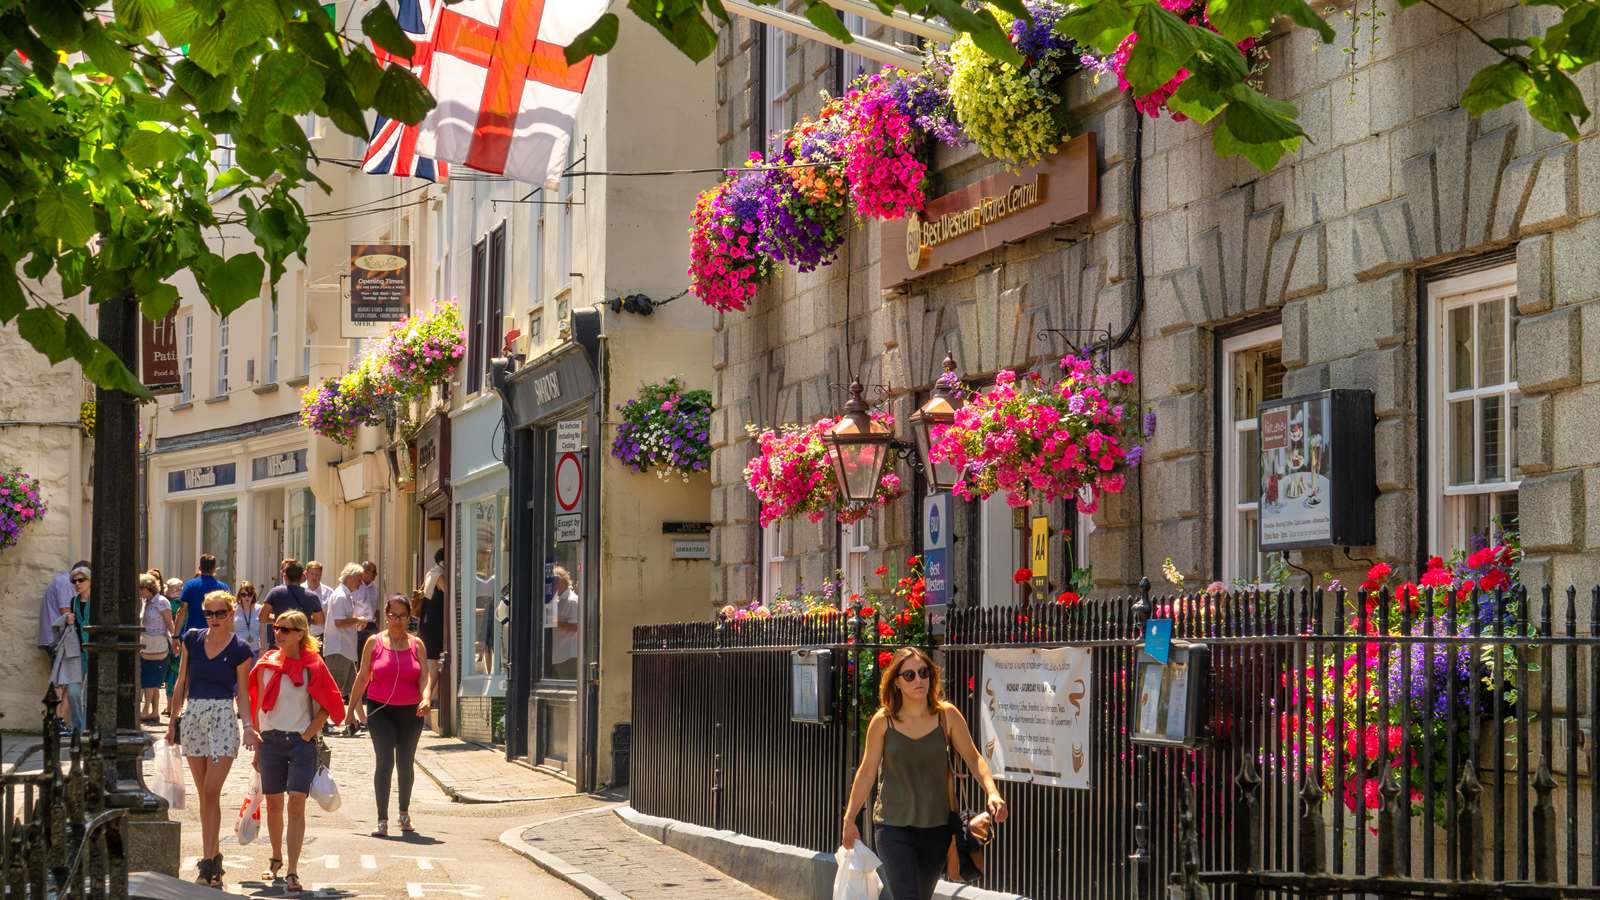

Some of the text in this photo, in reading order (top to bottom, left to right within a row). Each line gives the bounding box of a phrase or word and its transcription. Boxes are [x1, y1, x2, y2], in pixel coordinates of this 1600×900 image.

[922, 220, 941, 247] Best
[942, 208, 977, 241] Western
[1008, 180, 1039, 213] Central
[358, 278, 385, 286] Opening
[558, 517, 580, 529] Except by
[561, 529, 576, 538] permit
[1034, 533, 1045, 561] AA
[929, 561, 940, 576] Best
[926, 577, 945, 592] Western
